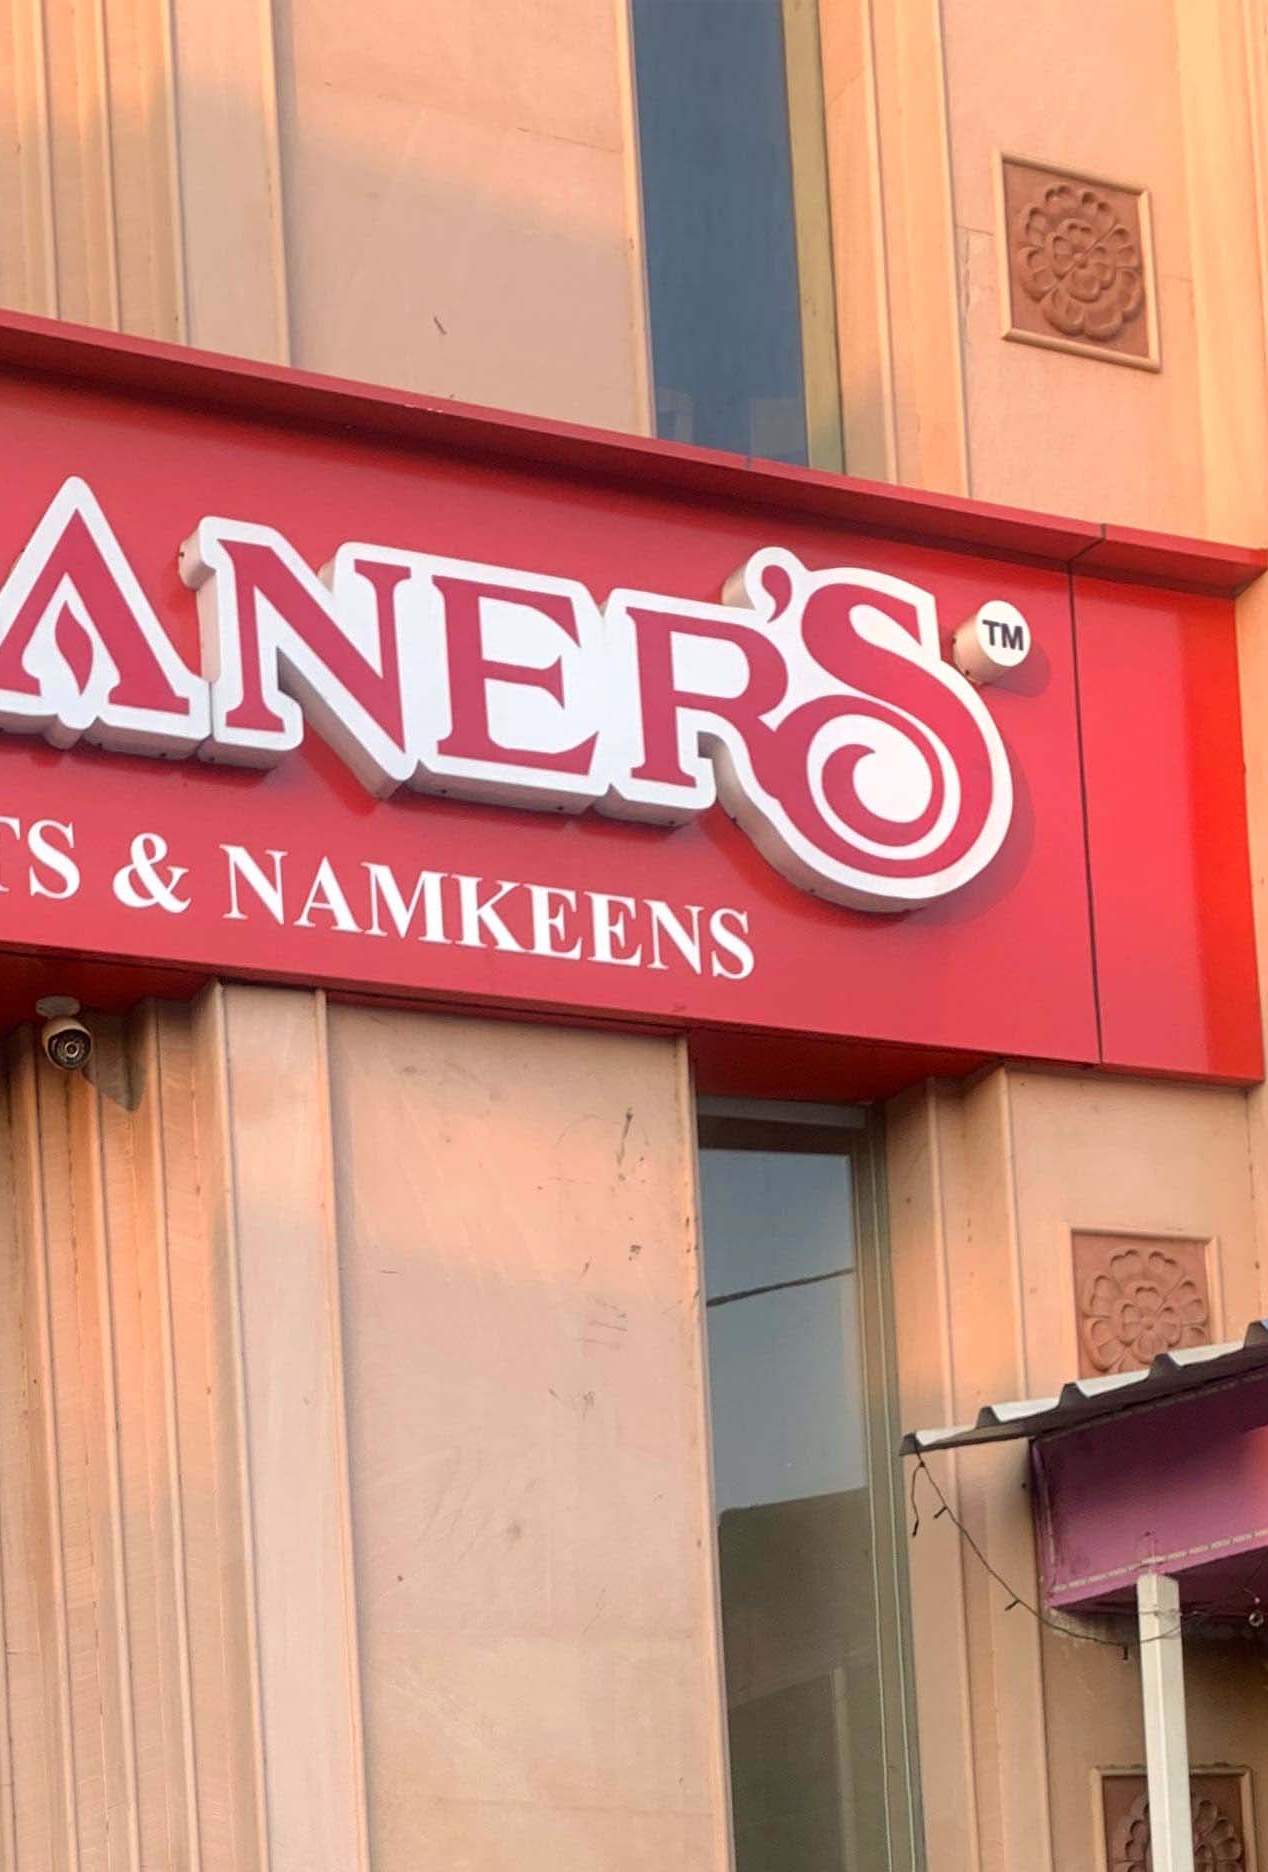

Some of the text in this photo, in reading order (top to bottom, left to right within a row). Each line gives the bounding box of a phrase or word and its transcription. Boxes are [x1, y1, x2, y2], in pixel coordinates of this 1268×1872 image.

[981, 619, 1026, 653] TM
[112, 830, 192, 915] &
[221, 842, 756, 980] NAMKEENS
